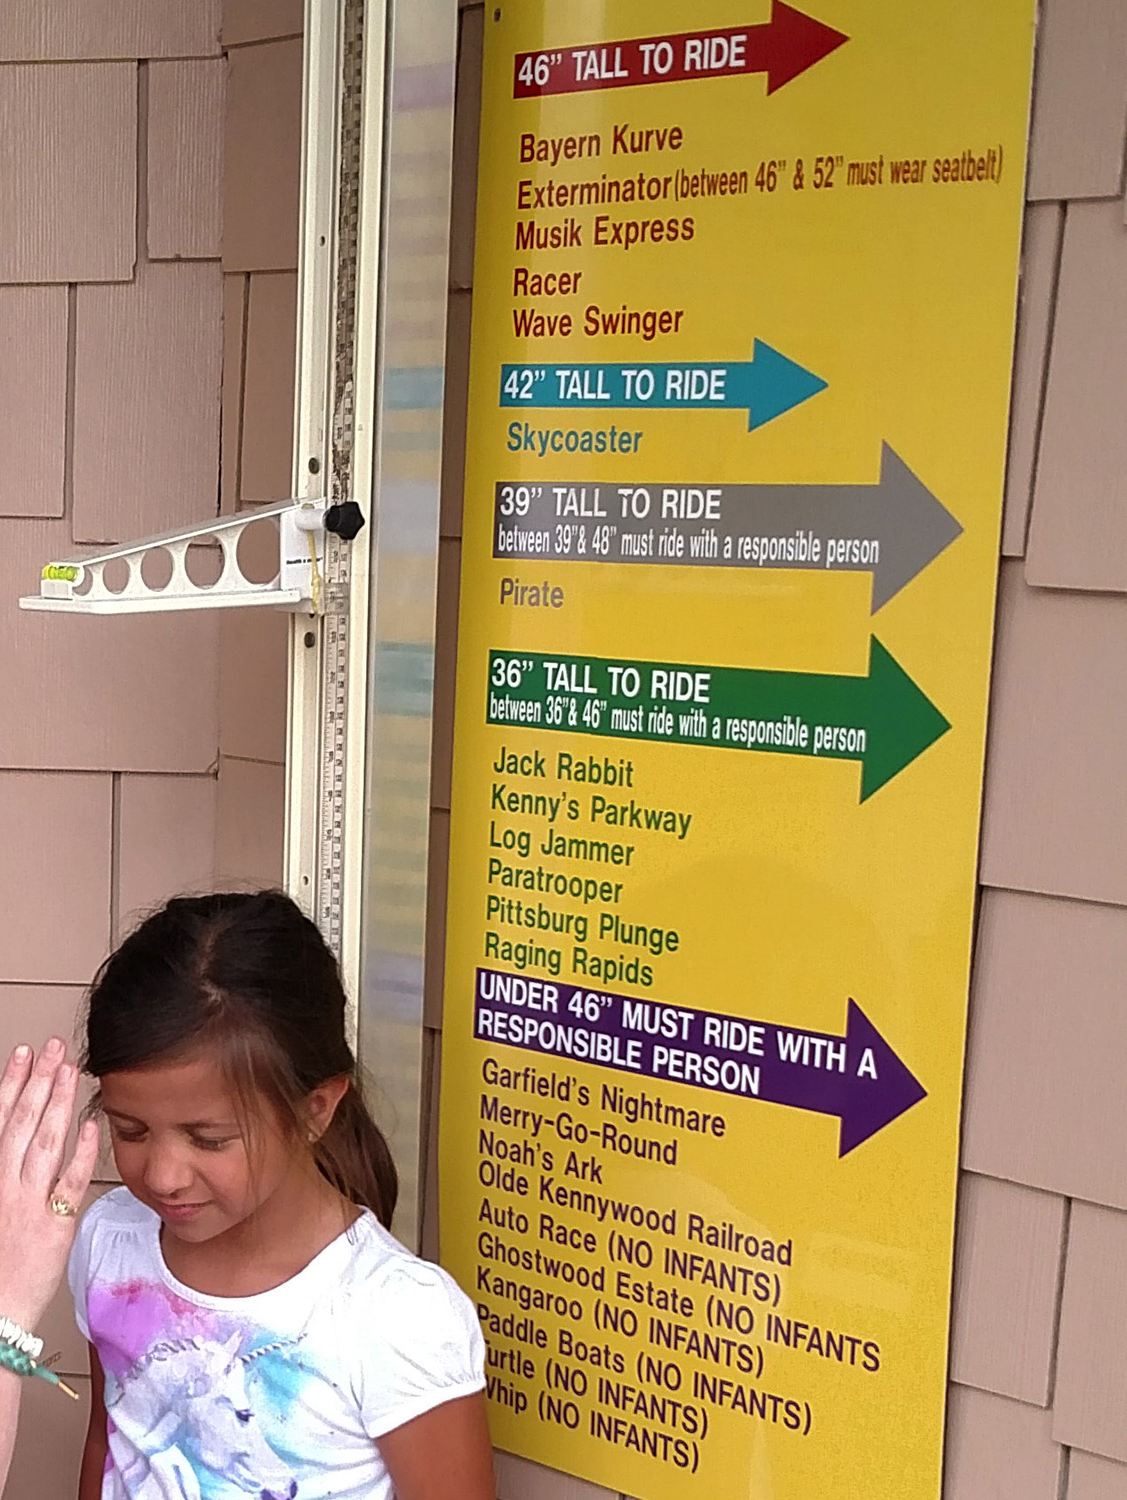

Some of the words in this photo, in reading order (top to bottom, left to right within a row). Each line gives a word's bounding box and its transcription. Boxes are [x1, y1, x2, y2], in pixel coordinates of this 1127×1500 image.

[572, 48, 628, 81] TALL
[639, 42, 673, 74] TO
[685, 35, 746, 71] RIDE
[520, 134, 600, 166] Bayern
[613, 124, 682, 154] Kurve
[793, 160, 804, 190] &
[847, 155, 884, 185] must
[890, 160, 926, 184] wear
[932, 145, 1003, 183] seatbelt)
[516, 219, 581, 250] Musik
[595, 216, 694, 250] Express
[514, 268, 581, 296] Racer
[513, 309, 571, 337] Wave
[584, 306, 683, 340] Swinger
[556, 370, 610, 399] TALL
[622, 369, 654, 400] TO
[666, 370, 726, 400] RIDE
[507, 422, 643, 457] Skycoaster
[553, 488, 606, 516] TALL
[618, 488, 650, 518] TO
[662, 489, 721, 519] RIDE
[499, 524, 549, 552] between
[621, 529, 653, 556] must
[659, 528, 684, 557] ride
[690, 528, 717, 557] with
[724, 536, 732, 558] a
[738, 531, 820, 565] responsible
[826, 539, 879, 568] person
[500, 578, 563, 608] Pirate
[543, 662, 597, 693] TALL
[608, 667, 640, 697] TO
[651, 670, 710, 702] RIDE
[490, 692, 541, 722] between
[611, 706, 643, 731] must
[648, 706, 673, 735] ride
[679, 708, 706, 737] with
[712, 717, 720, 739] a
[726, 716, 808, 747] responsible
[814, 726, 865, 754] person
[494, 747, 545, 777] Jack
[558, 753, 633, 787] Rabbit
[591, 796, 691, 839] Parkway
[490, 821, 530, 857] Log
[541, 829, 634, 866] Jammer
[488, 858, 623, 904] Paratrooper
[487, 895, 587, 944] Pittsburg
[600, 913, 679, 955] Plunge
[485, 932, 561, 975] Raging
[573, 947, 652, 986] Rapids
[481, 973, 558, 1013] UNDER
[623, 1001, 694, 1040] MUST
[704, 1017, 765, 1055] RIDE
[777, 1031, 846, 1072] WITH
[857, 1049, 877, 1079] A
[479, 1009, 642, 1068] RESPONSIBLE
[653, 1046, 759, 1094] PERSON
[479, 1093, 677, 1167] Merry-Go-Round
[602, 1084, 725, 1137] Nightmare
[565, 1152, 602, 1184] Ark
[479, 1160, 528, 1195] Olde
[540, 1175, 675, 1241] Kennywood
[688, 1214, 792, 1266] Railroad
[479, 1198, 528, 1233] Auto
[540, 1214, 596, 1252] Race
[609, 1230, 652, 1268] (NO
[665, 1248, 780, 1307] INFANTS)
[477, 1229, 604, 1297] Ghostwood
[617, 1272, 693, 1317] Estate
[707, 1295, 753, 1334] (NO
[767, 1314, 879, 1371] INFANTS
[477, 1263, 582, 1320] Kangaroo
[595, 1299, 637, 1337] (NO
[650, 1317, 763, 1378] INFANTS)
[477, 1303, 547, 1348] Paddle
[559, 1329, 624, 1373] Boats
[637, 1352, 681, 1390] (NO
[694, 1372, 811, 1440] INFANTS)
[484, 1339, 534, 1379] urtle
[546, 1358, 587, 1396] (NO
[597, 1372, 707, 1443] INFANTS)
[539, 1391, 579, 1428] (NO
[591, 1406, 698, 1473] INFANTS)
